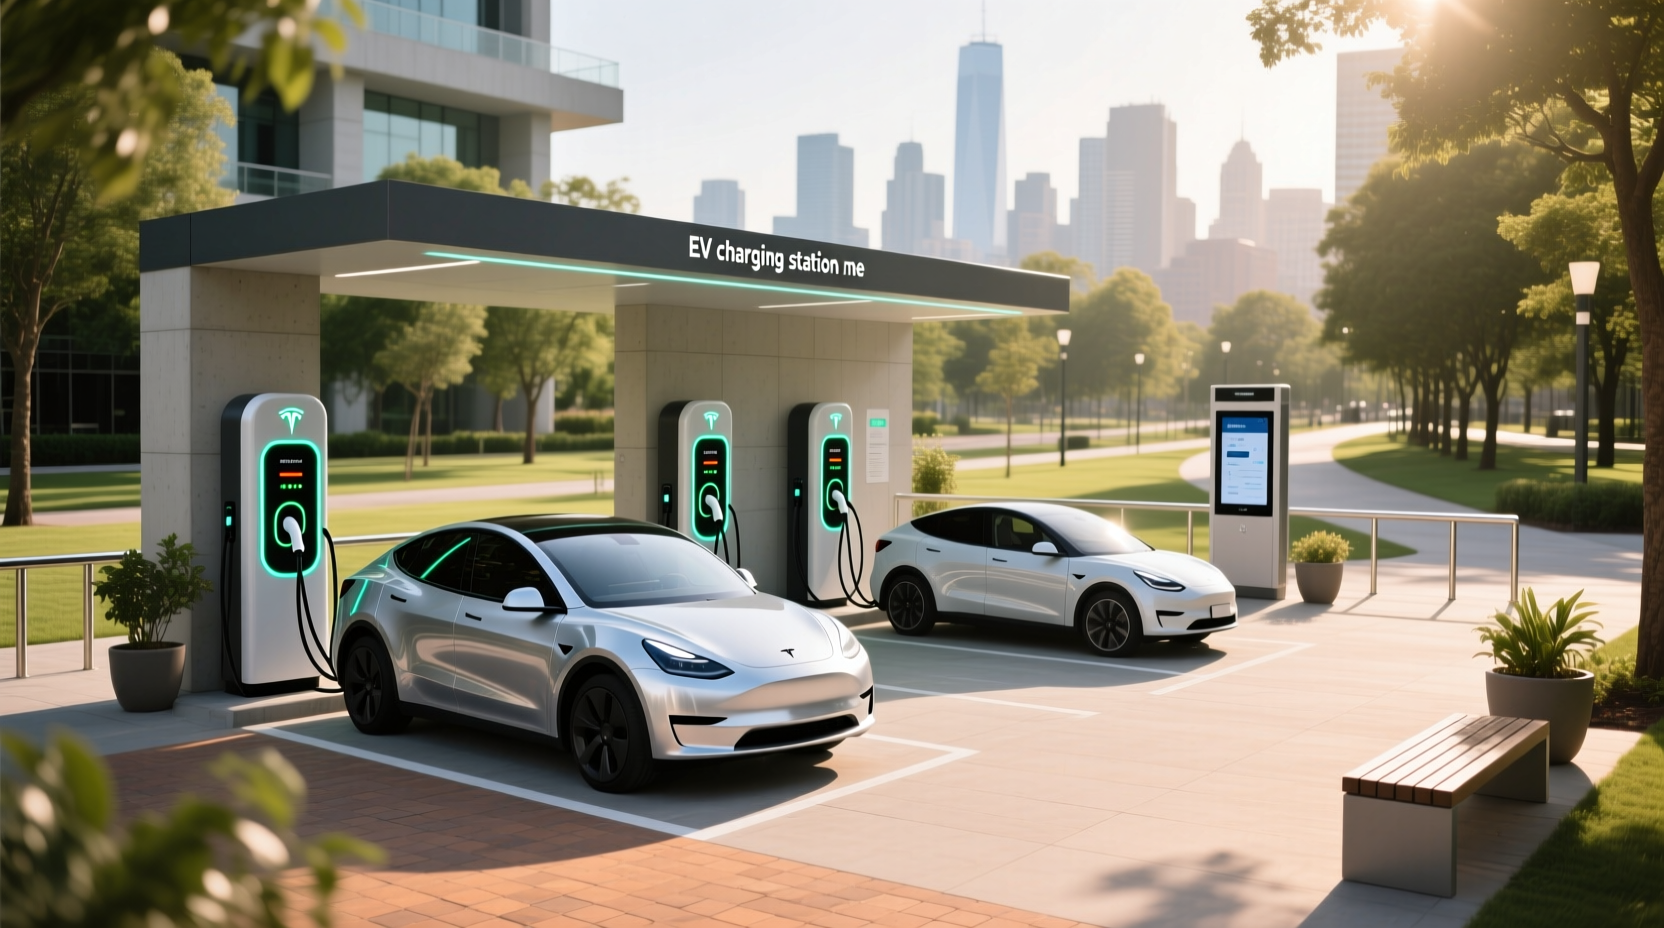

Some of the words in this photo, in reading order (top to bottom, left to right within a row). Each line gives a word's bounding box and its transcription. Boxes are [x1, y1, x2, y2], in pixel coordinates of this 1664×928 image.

[689, 235, 713, 259] EV
[716, 239, 785, 274] charging
[788, 251, 840, 275] station
[843, 260, 866, 277] me
